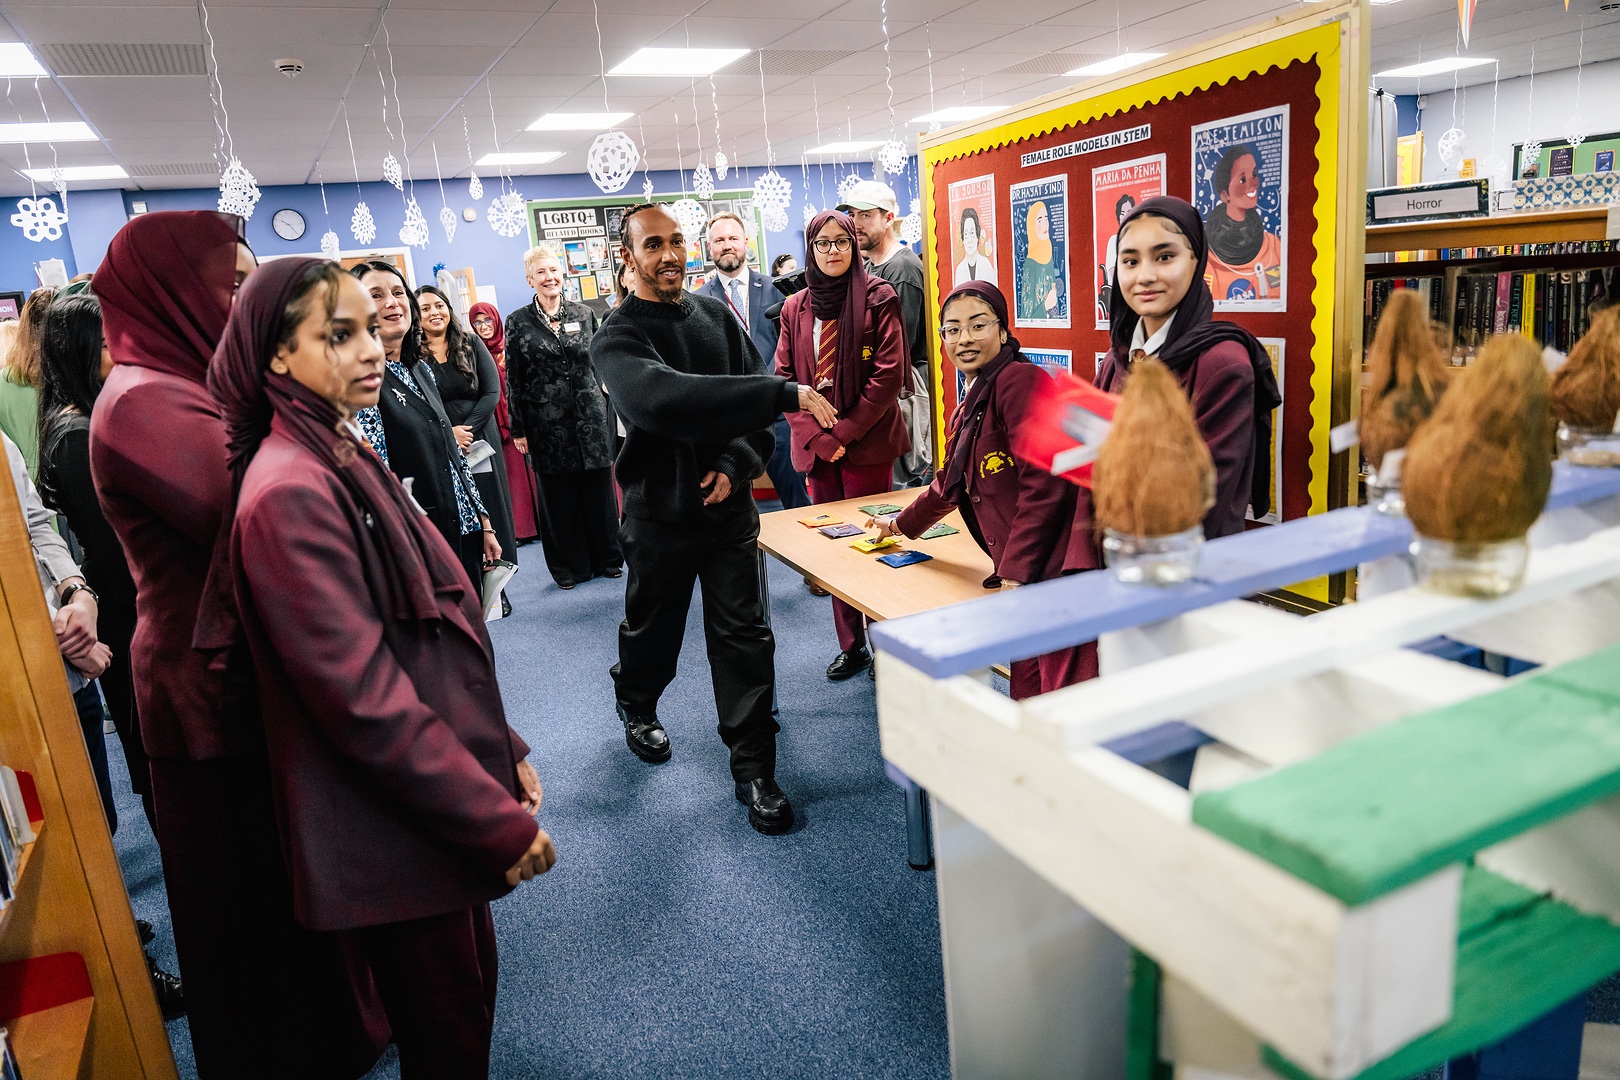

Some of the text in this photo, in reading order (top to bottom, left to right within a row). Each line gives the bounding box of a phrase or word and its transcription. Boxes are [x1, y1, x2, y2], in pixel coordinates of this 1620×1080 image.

[1195, 115, 1282, 147] MAE JEMISON
[1022, 126, 1149, 165] FEMALE ROLE MODELS IN STEM
[1095, 171, 1119, 187] MARIA
[1121, 168, 1132, 181] DA
[1133, 162, 1161, 180] PENHA
[1021, 185, 1043, 199] HAYAT
[1044, 181, 1064, 195] SINDI
[1406, 199, 1442, 210] Horror
[543, 211, 594, 225] LGBTQ+
